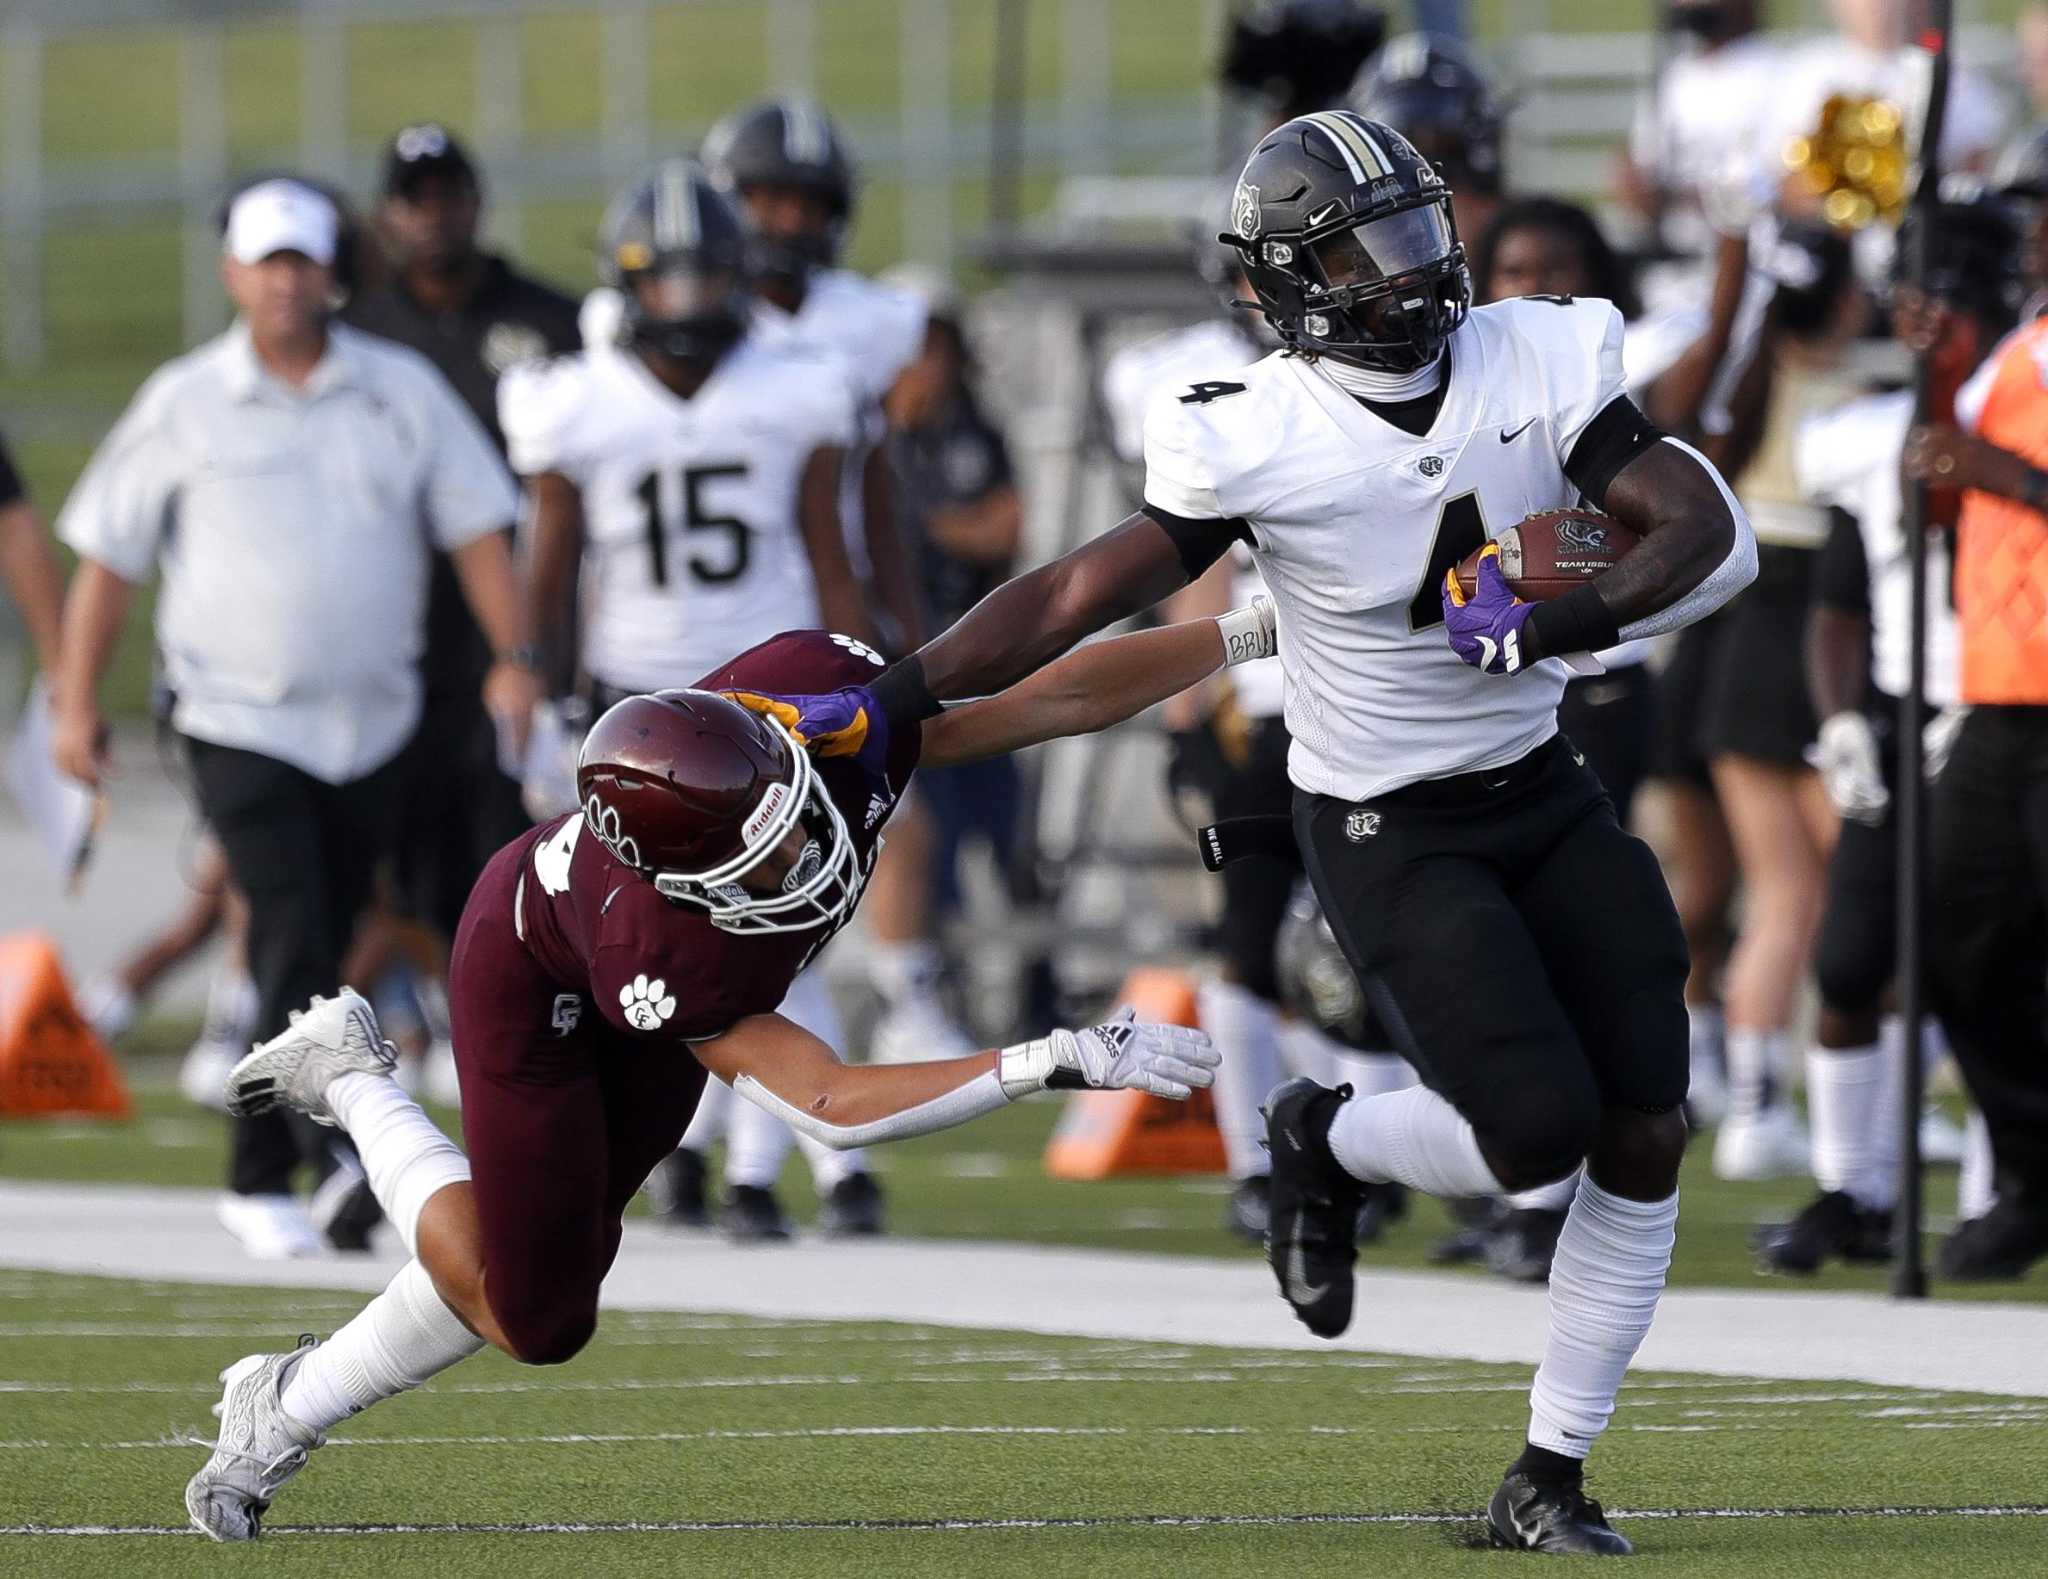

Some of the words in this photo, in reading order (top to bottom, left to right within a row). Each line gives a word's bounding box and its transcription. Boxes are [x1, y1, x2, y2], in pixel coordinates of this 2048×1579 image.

[1176, 380, 1247, 406] 4
[637, 464, 751, 588] 15
[1555, 561, 1586, 569] TEAM
[750, 787, 782, 836] Riddell
[1207, 827, 1217, 841] WE
